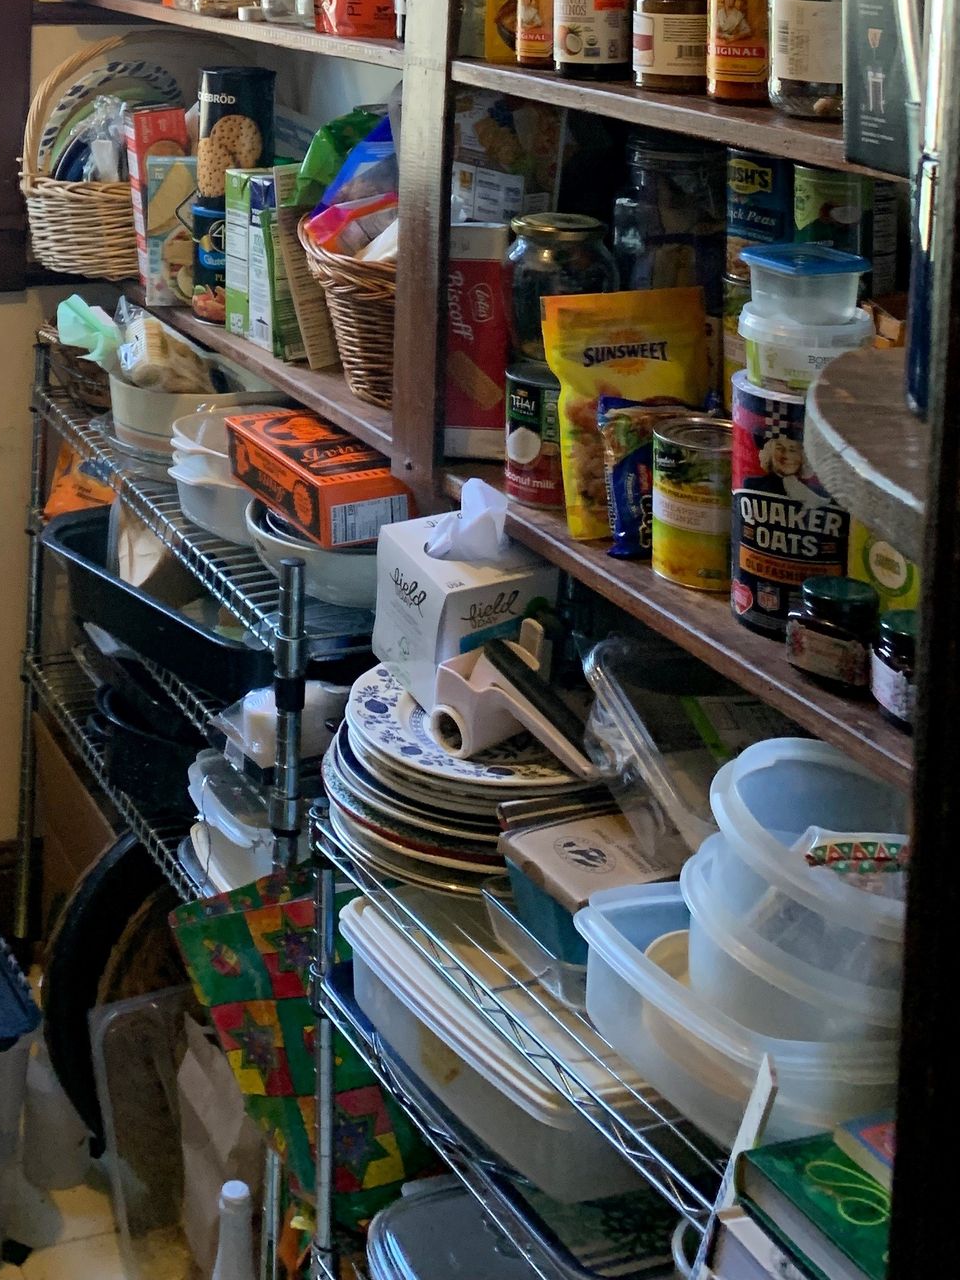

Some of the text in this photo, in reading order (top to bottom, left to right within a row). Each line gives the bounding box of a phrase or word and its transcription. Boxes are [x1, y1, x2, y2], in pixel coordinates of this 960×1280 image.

[732, 168, 770, 189] USH'S
[747, 210, 776, 226] Peas
[448, 271, 474, 341] Biscoff
[583, 341, 668, 368] SUNSWEET
[510, 394, 536, 411] THAI
[532, 480, 555, 489] milk
[741, 496, 843, 538] QUAKER
[756, 526, 819, 557] OATS
[460, 590, 520, 622] field
